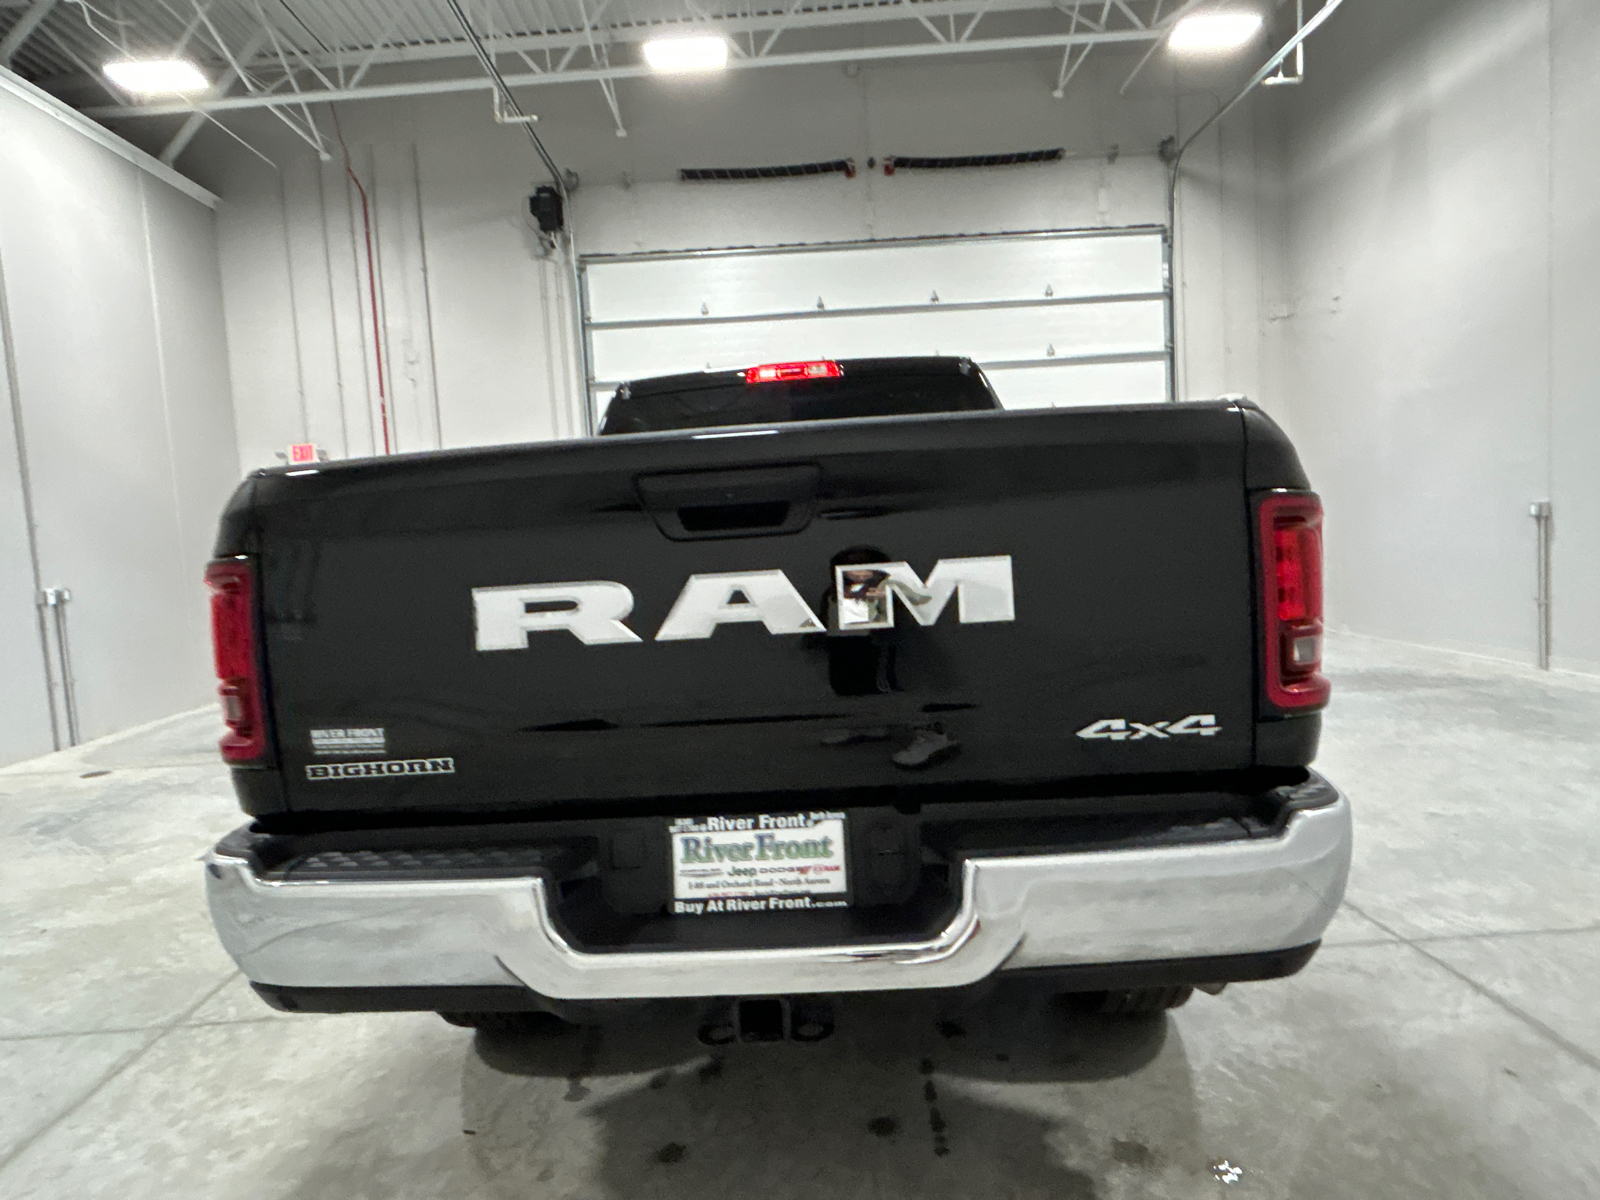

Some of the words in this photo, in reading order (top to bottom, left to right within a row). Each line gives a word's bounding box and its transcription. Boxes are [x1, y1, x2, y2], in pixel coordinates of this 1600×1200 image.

[292, 444, 313, 462] EXIT
[471, 555, 1015, 651] RAM
[1075, 714, 1223, 740] 4x4
[305, 757, 455, 780] BIGHORN
[707, 816, 754, 831] River
[758, 813, 805, 829] Front
[727, 866, 757, 877] Jeep
[674, 901, 705, 916] Buy
[706, 900, 724, 912] At
[725, 898, 767, 911] River
